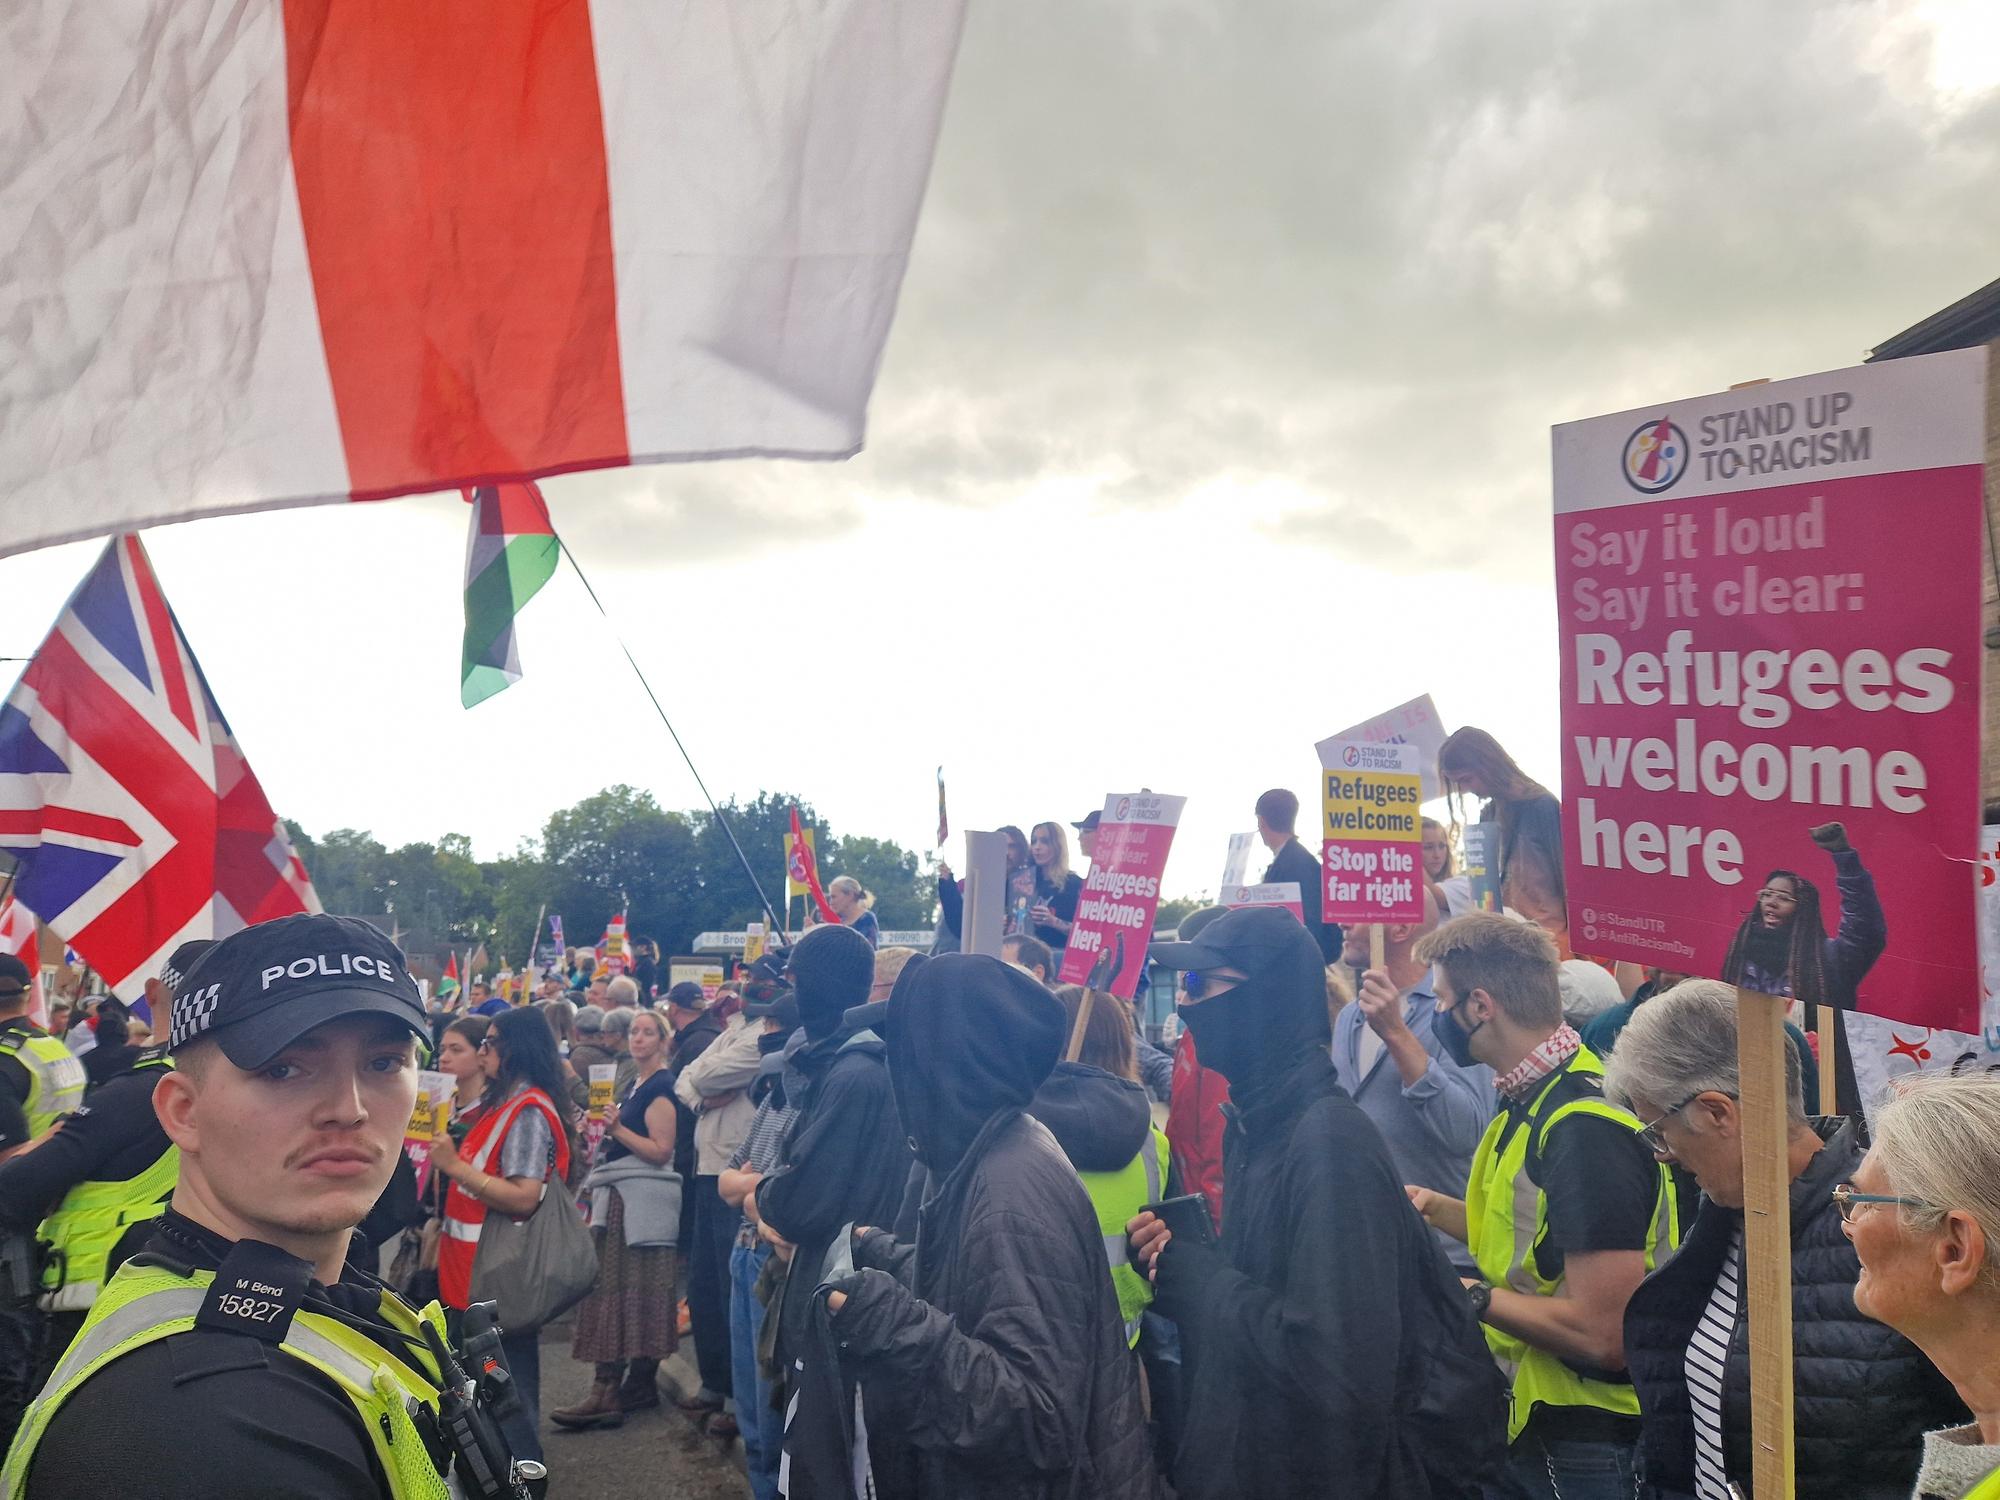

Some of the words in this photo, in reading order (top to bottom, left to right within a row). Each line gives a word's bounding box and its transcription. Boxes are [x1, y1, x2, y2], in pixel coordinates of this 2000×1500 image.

[1699, 401, 1796, 447] STAND
[1804, 392, 1853, 429] UP
[1749, 427, 1872, 476] RACISM
[1570, 522, 1648, 576] Say
[1662, 513, 1697, 560] it
[1713, 496, 1825, 556] loud
[1573, 577, 1650, 631] Say
[1664, 572, 1699, 618] it
[1713, 565, 1864, 616] clear:
[1575, 629, 1954, 729] Refugees
[1361, 747, 1386, 757] STAND
[1388, 749, 1398, 759] UP
[1361, 758, 1373, 768] TO
[1574, 718, 1927, 814] welcome
[1328, 776, 1418, 807] Refugees
[1328, 807, 1414, 831] welcome
[1578, 798, 1744, 886] here
[1327, 845, 1377, 877] Stop
[1381, 847, 1413, 872] the
[1087, 863, 1158, 900] Refugees
[1328, 876, 1360, 902] far
[1366, 877, 1413, 907] right
[1080, 894, 1146, 929] welcome
[1069, 921, 1102, 953] here
[262, 953, 395, 991] POLICE
[235, 1278, 249, 1289] M
[251, 1281, 284, 1297] Bend
[218, 1293, 285, 1324] 15827
